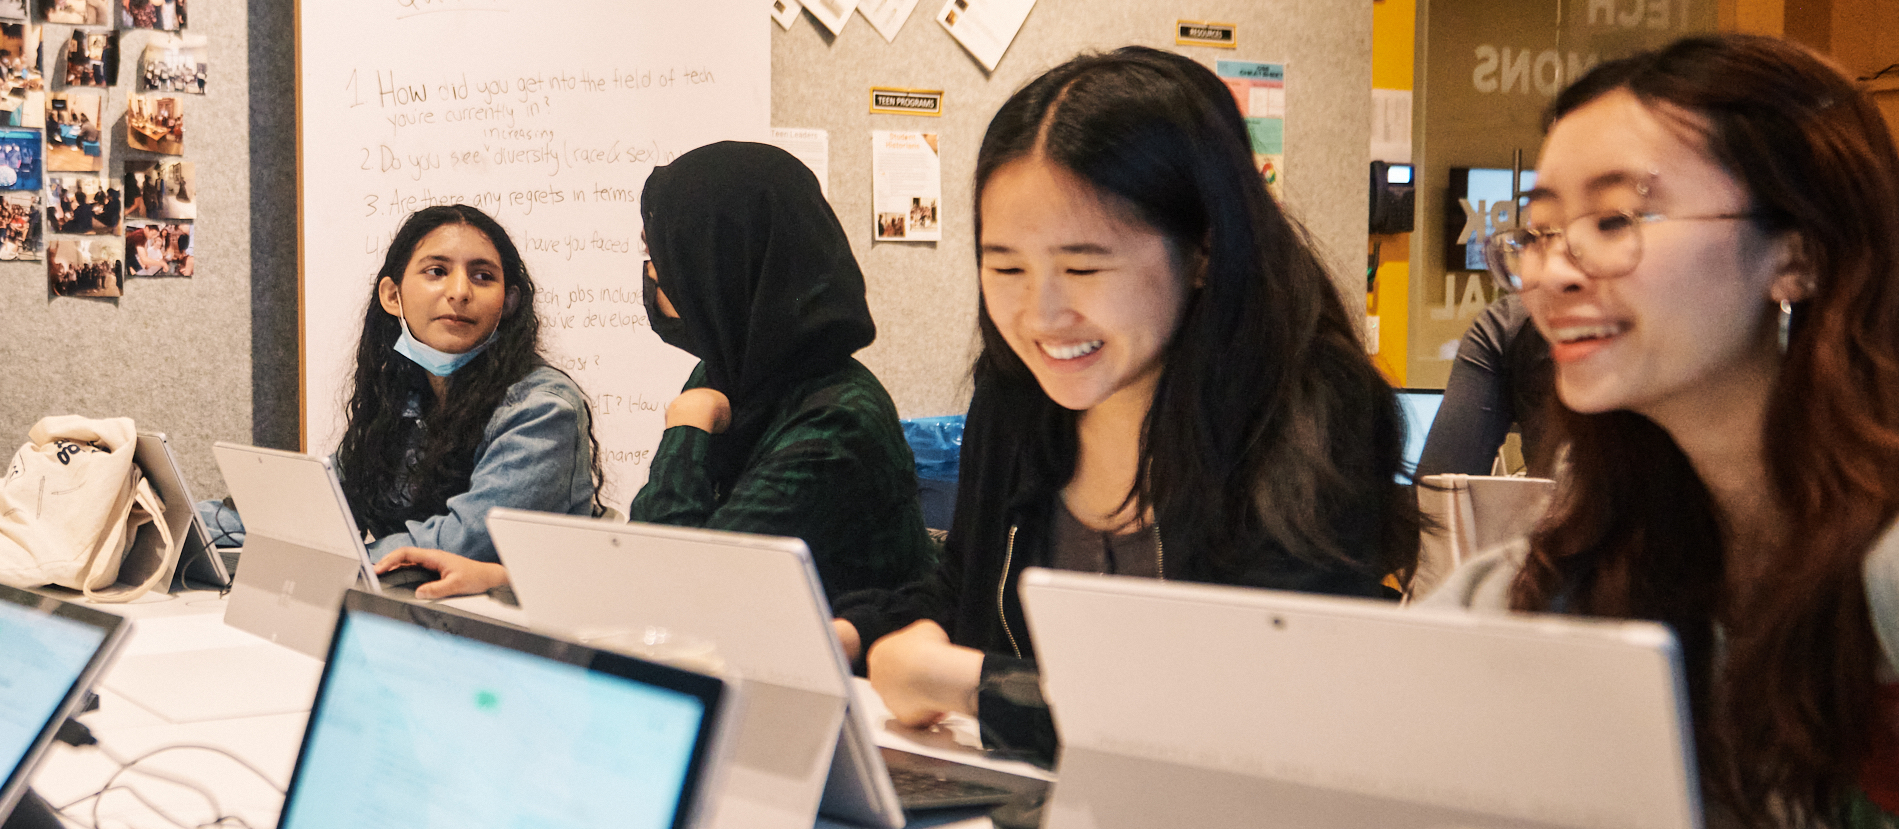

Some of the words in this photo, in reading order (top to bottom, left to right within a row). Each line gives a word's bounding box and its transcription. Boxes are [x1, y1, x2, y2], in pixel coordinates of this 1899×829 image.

[376, 69, 427, 107] How
[438, 72, 469, 101] did
[476, 79, 509, 104] you
[516, 72, 545, 103] get
[580, 69, 606, 91] the
[612, 68, 652, 90] field
[659, 68, 676, 87] of
[683, 66, 716, 85] tech
[877, 97, 895, 106] TEEN
[896, 98, 935, 109] PROGRAMS
[387, 109, 436, 137] you're
[445, 103, 515, 129] currently
[484, 127, 555, 143] increasing
[380, 144, 402, 173] Do
[408, 152, 441, 182] you
[450, 150, 482, 168] see
[494, 143, 561, 177] diversity
[626, 140, 660, 167] sex)
[389, 188, 417, 216] Are
[420, 188, 465, 207] there
[473, 191, 501, 219] any
[509, 184, 565, 216] regrets
[572, 188, 586, 203] in
[592, 181, 636, 203] terms
[524, 230, 560, 254] have
[564, 235, 586, 262] you
[589, 230, 629, 254] faced
[535, 287, 560, 307] ech
[566, 283, 595, 310] jobs
[541, 311, 576, 330] ou've
[628, 394, 659, 413] How
[601, 447, 650, 466] hange
